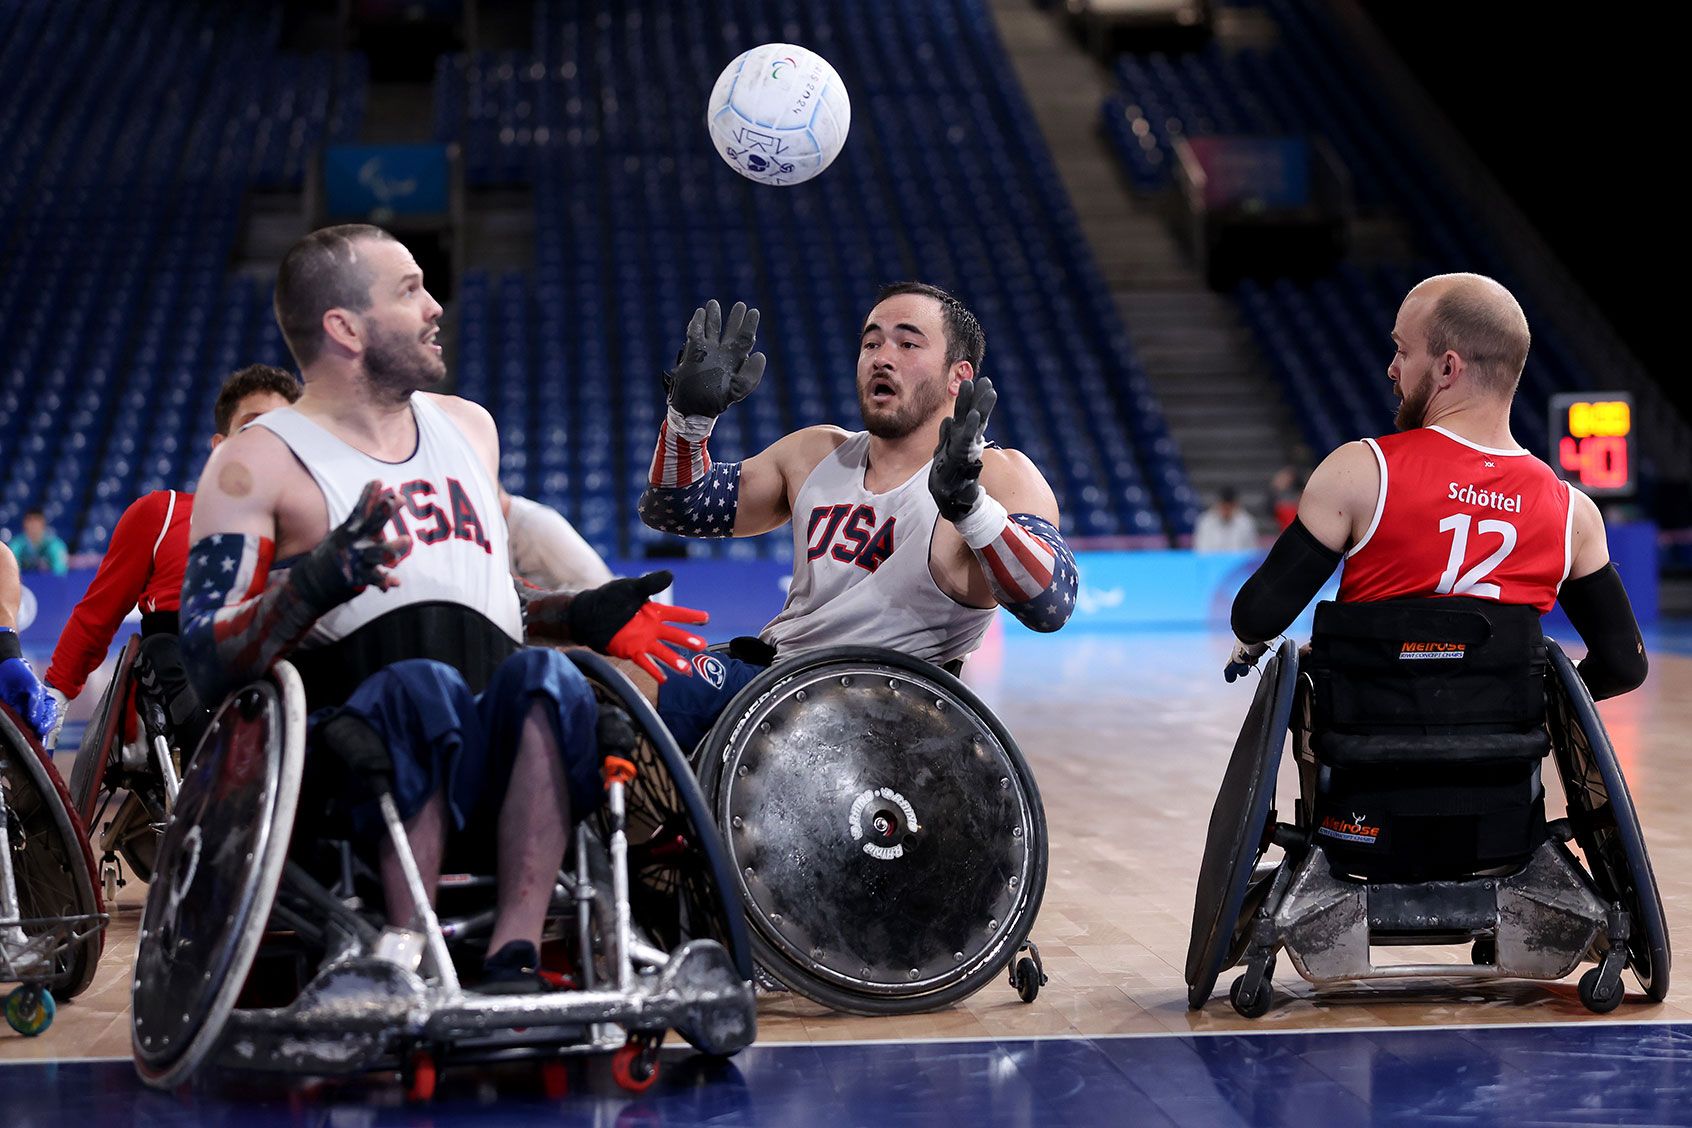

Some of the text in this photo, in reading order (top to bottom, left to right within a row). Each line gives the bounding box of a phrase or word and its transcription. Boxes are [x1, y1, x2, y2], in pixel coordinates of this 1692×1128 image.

[1448, 482, 1522, 513] Schöttel
[807, 503, 897, 575] USA
[1434, 513, 1518, 600] 12
[1402, 642, 1466, 652] Melrose
[1322, 816, 1380, 836] Melrose
